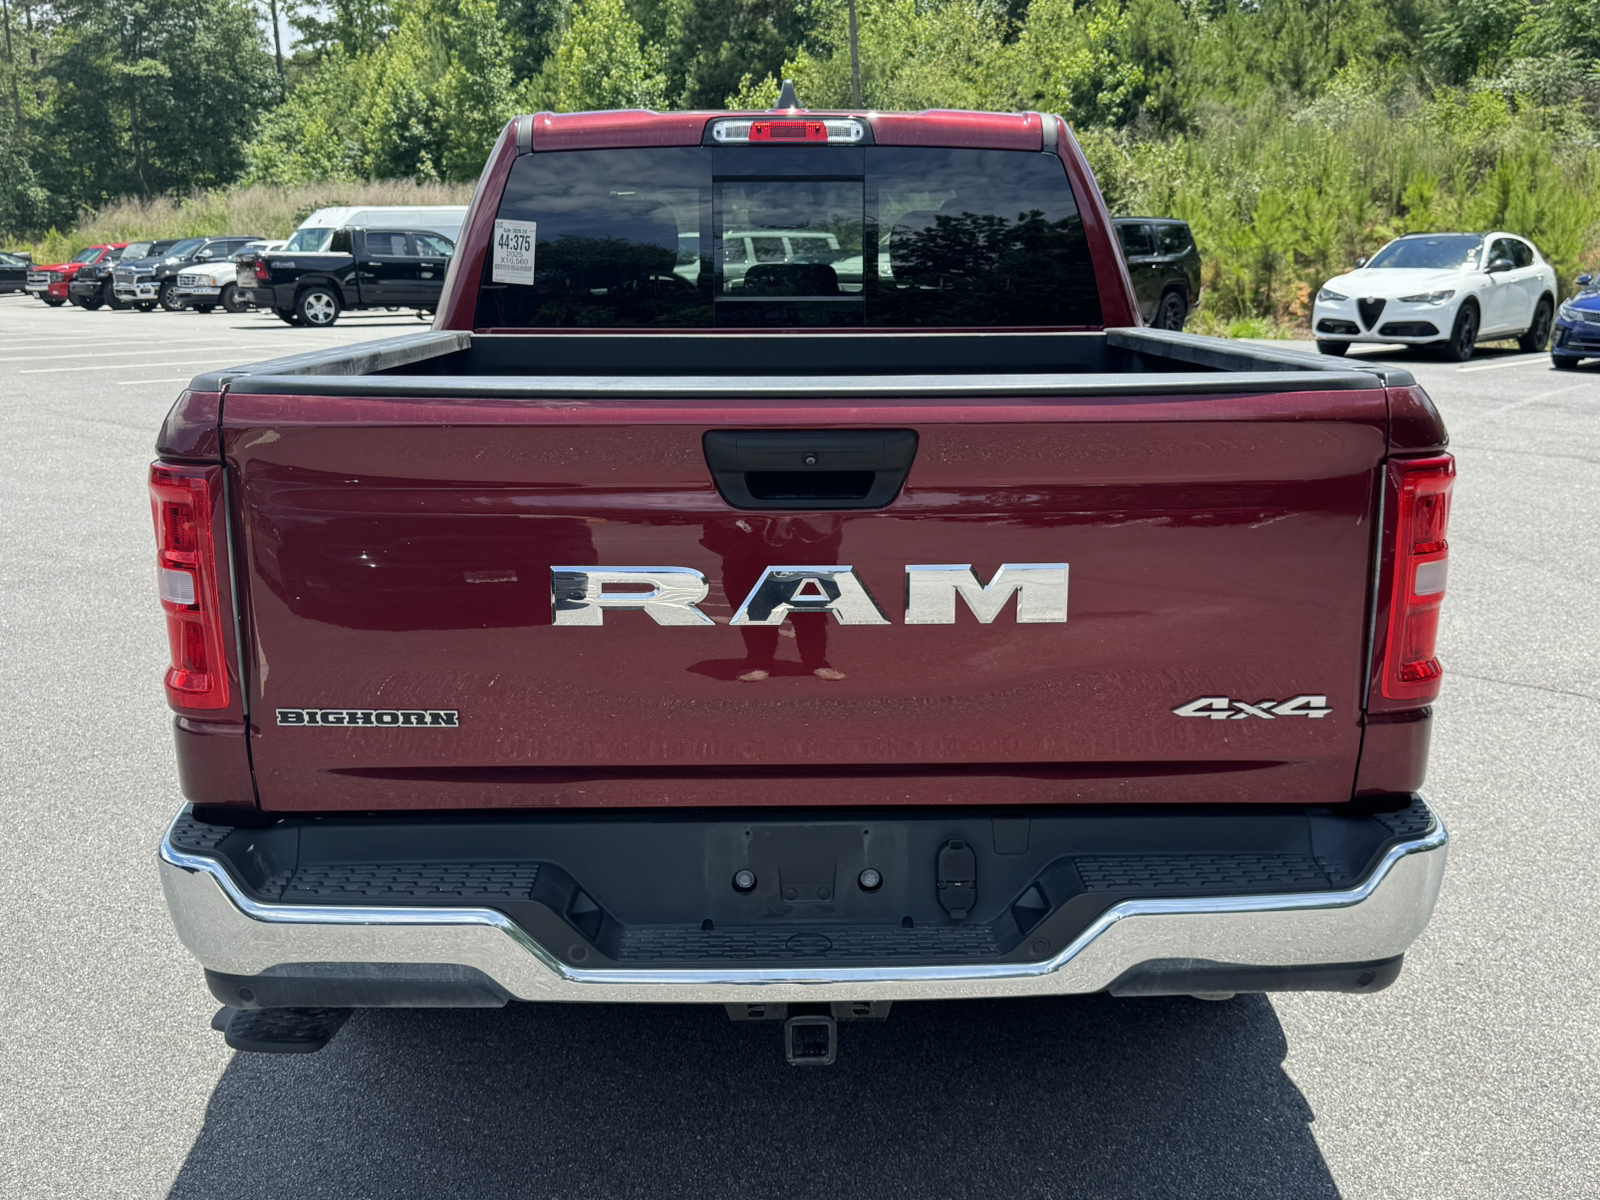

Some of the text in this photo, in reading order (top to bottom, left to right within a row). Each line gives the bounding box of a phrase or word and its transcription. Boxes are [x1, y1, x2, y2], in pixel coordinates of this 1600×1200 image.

[498, 233, 530, 251] 44:375
[549, 562, 1070, 626] RAM
[276, 708, 459, 727] BIGHORN
[1171, 695, 1333, 720] 4x4
